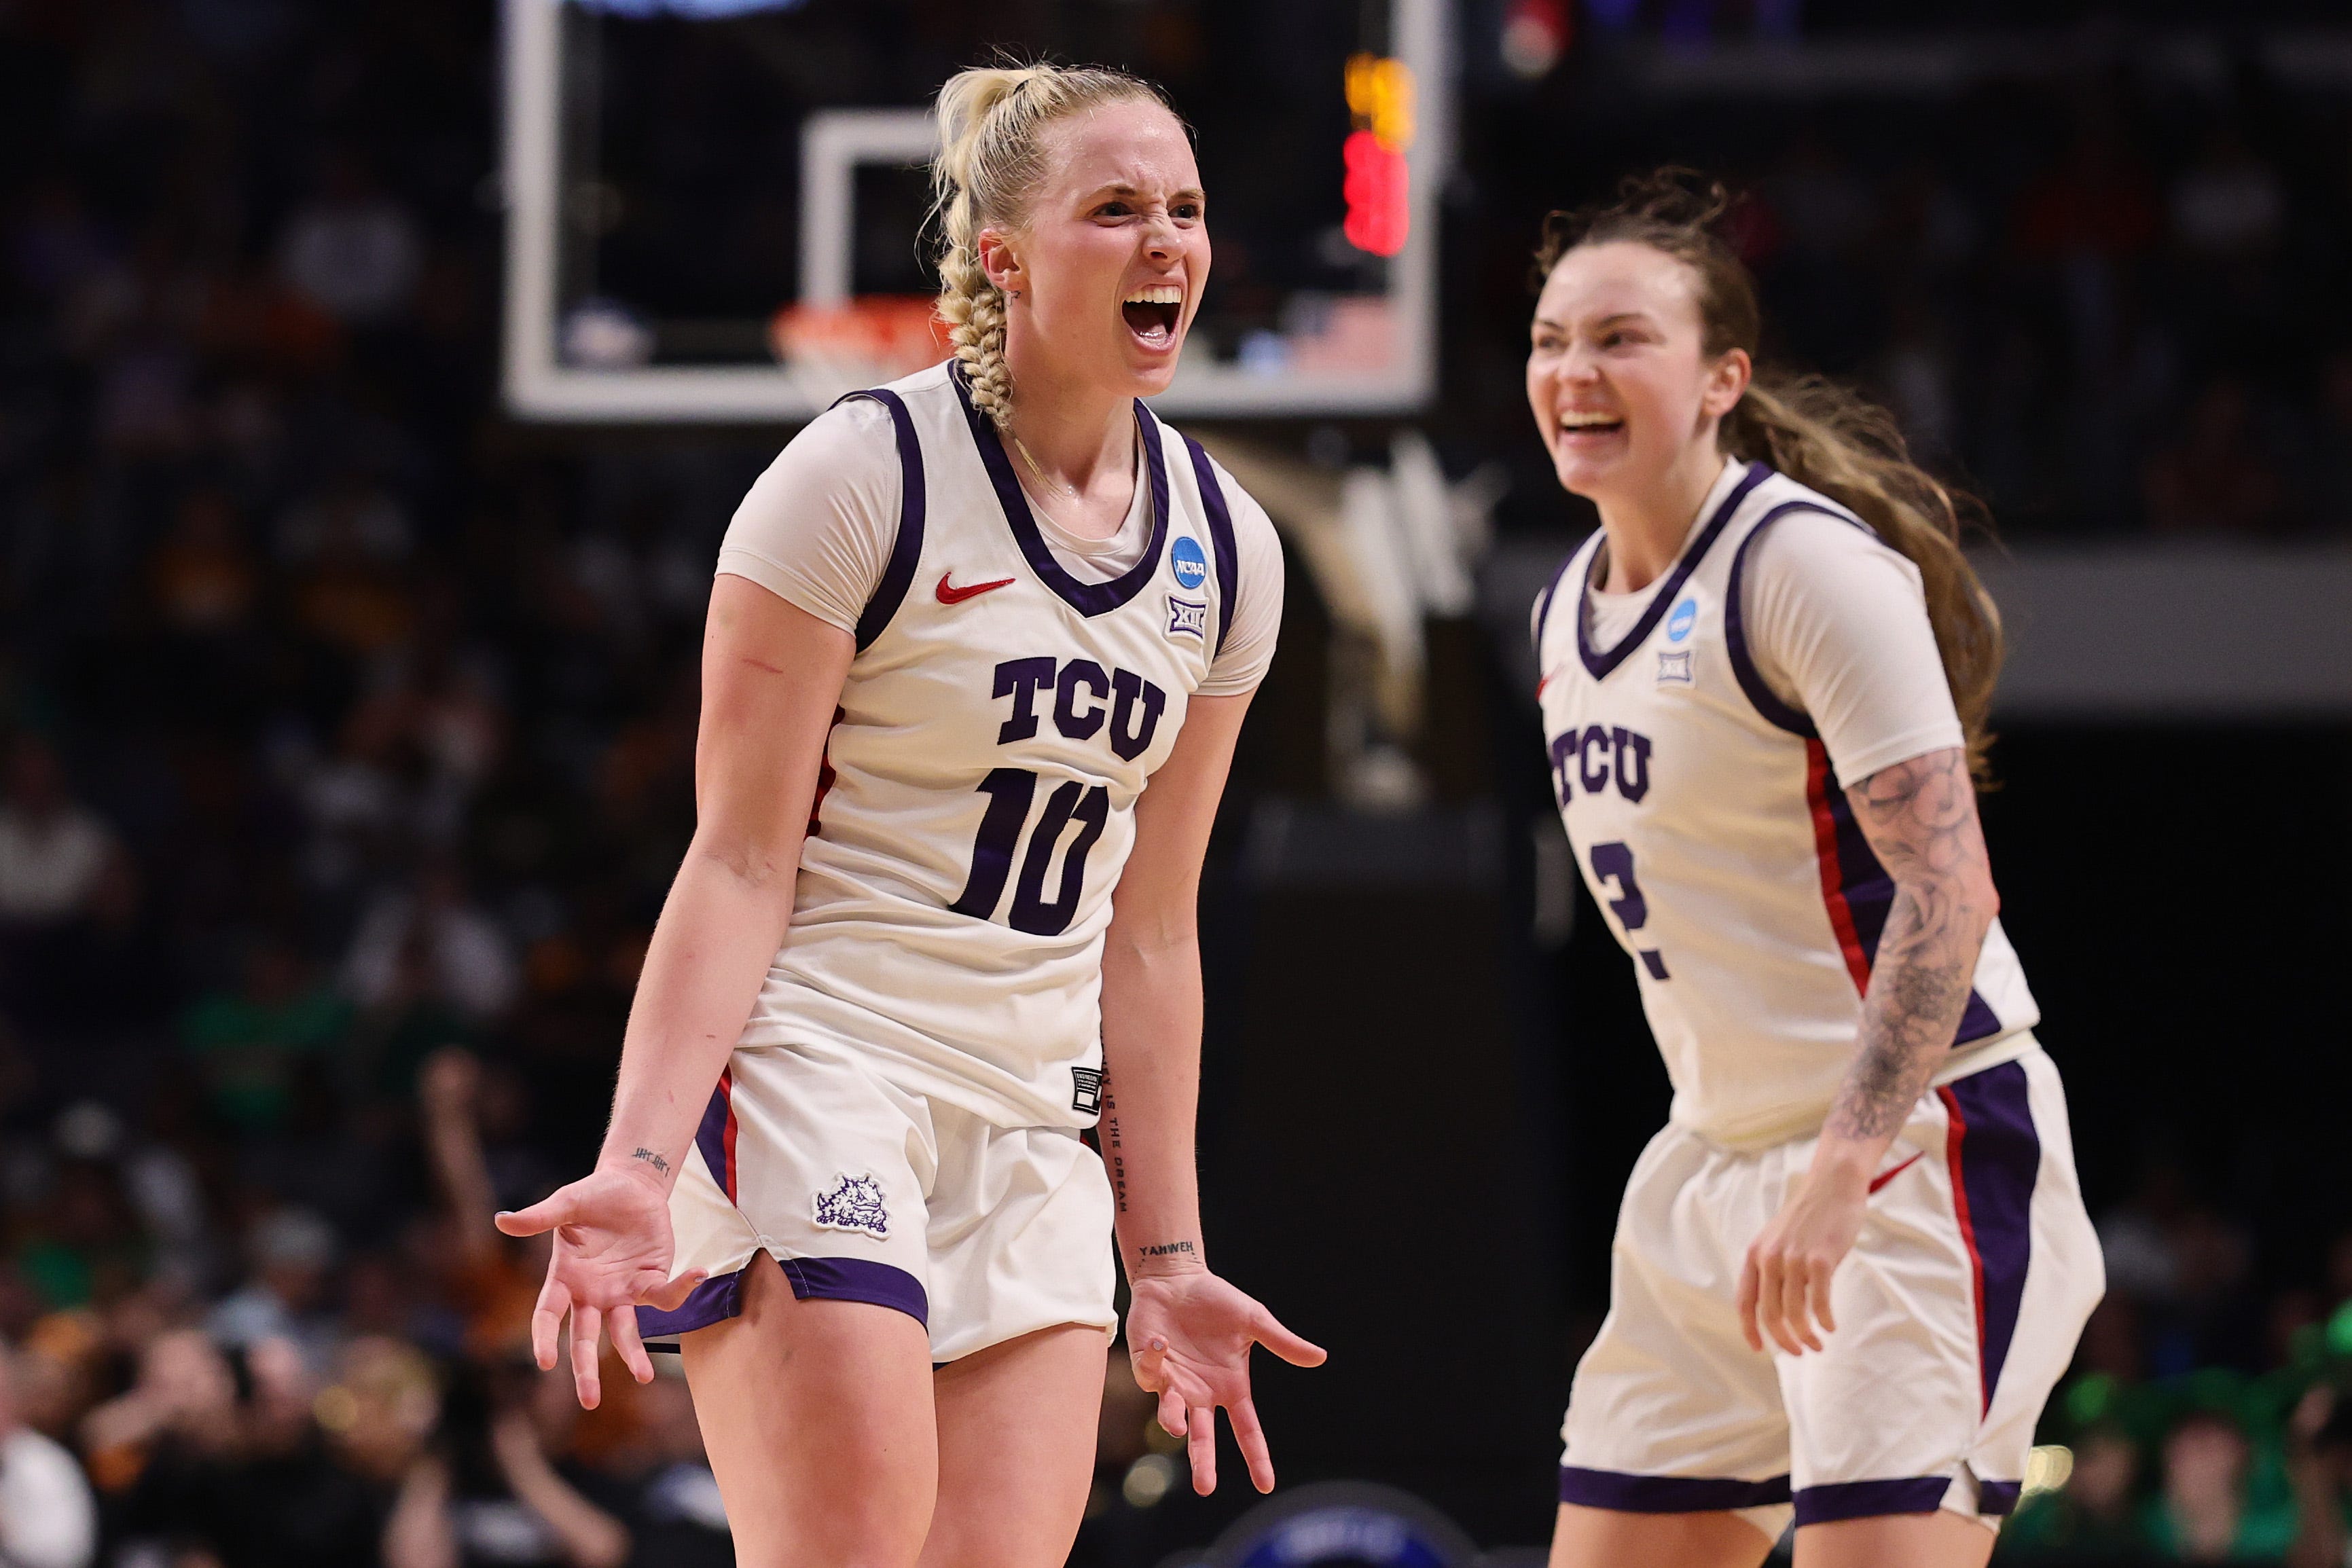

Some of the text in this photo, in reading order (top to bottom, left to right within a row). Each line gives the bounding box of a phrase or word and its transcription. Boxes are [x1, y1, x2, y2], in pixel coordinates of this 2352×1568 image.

[1176, 560, 1204, 577] NCAA
[992, 657, 1166, 762] TCU
[1551, 725, 1651, 809] TCU
[947, 767, 1109, 936] 10
[1591, 842, 1670, 980] 2
[1106, 1095, 1127, 1212] IS THE DREAM
